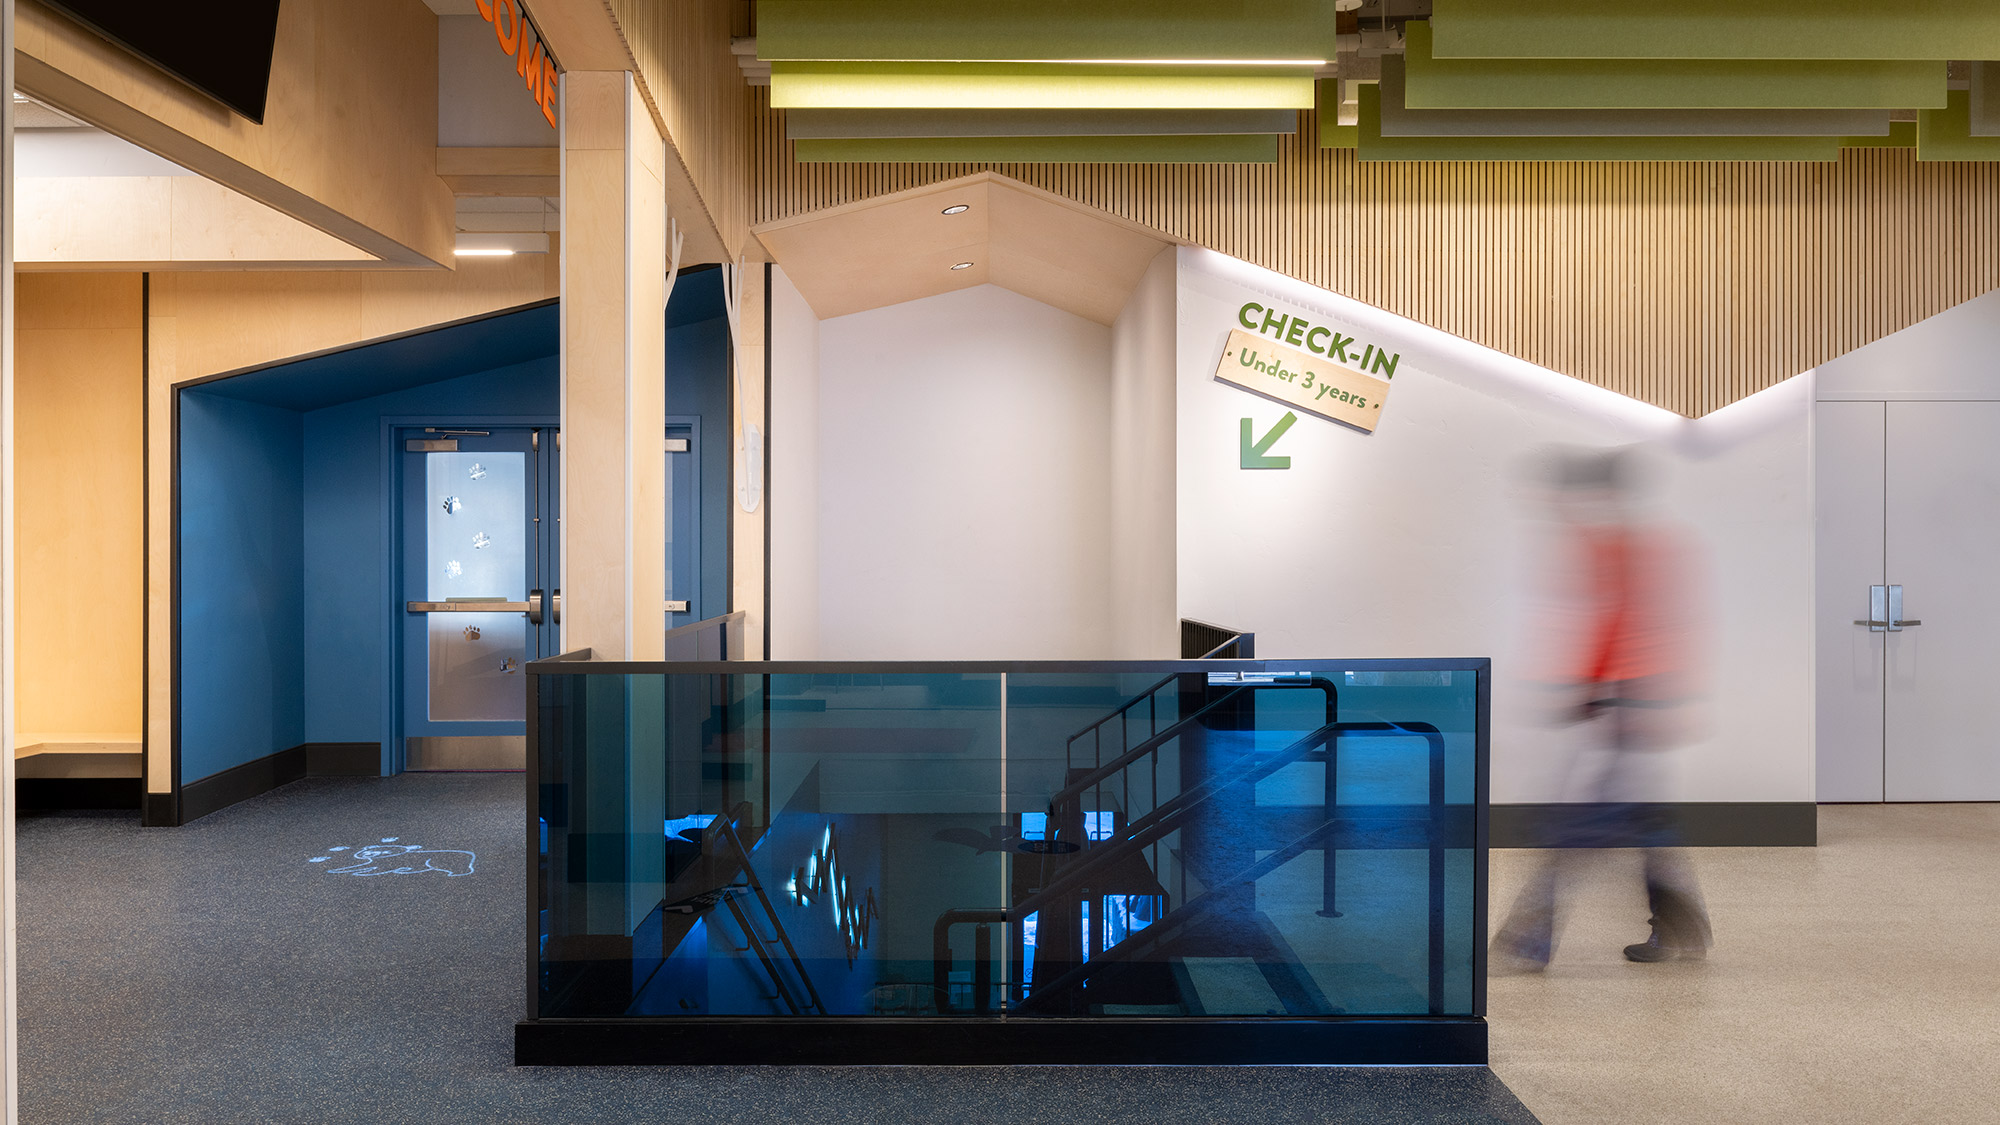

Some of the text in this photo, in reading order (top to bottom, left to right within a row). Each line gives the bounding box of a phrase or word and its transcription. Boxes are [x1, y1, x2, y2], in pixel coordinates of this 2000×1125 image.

[1239, 302, 1400, 380] CHECK-IN
[1239, 347, 1367, 409] Under 3 years
